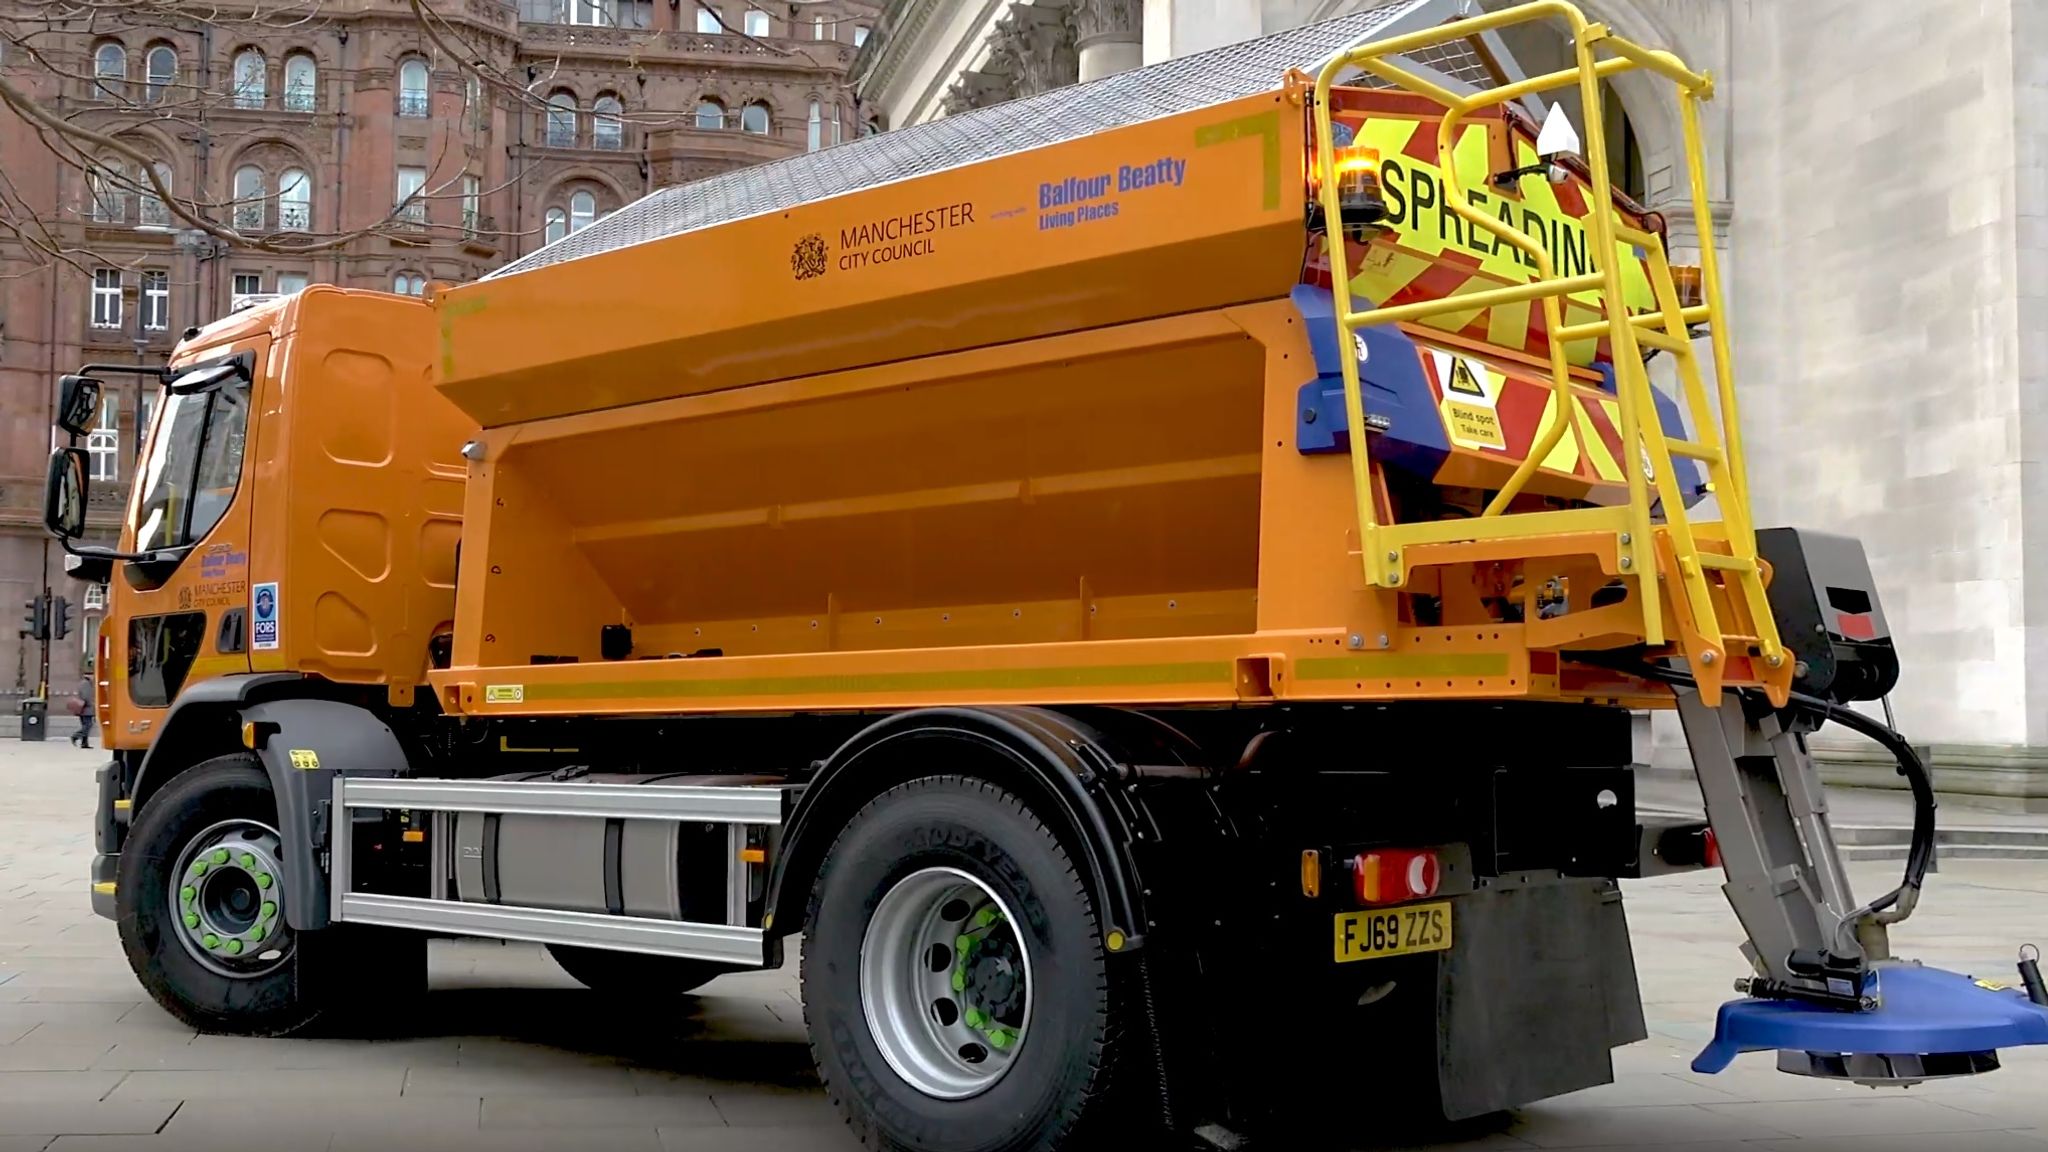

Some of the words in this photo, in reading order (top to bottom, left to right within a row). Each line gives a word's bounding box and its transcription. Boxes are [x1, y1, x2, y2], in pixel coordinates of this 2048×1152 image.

[1039, 174, 1112, 209] Balfour
[1118, 156, 1186, 193] Beatty
[840, 202, 975, 250] MANCHESTER
[1039, 211, 1075, 231] Living
[1077, 202, 1119, 223] Places
[1381, 159, 1597, 278] SPREADIN
[839, 251, 869, 271] CITY
[872, 238, 935, 264] COUNCIL
[1452, 408, 1474, 421] Blind
[1476, 414, 1495, 425] spot
[1460, 424, 1478, 435] Take
[1480, 429, 1495, 438] care
[255, 621, 275, 634] FORS
[1344, 915, 1399, 954] FJ69
[1405, 909, 1443, 946] ZZS
